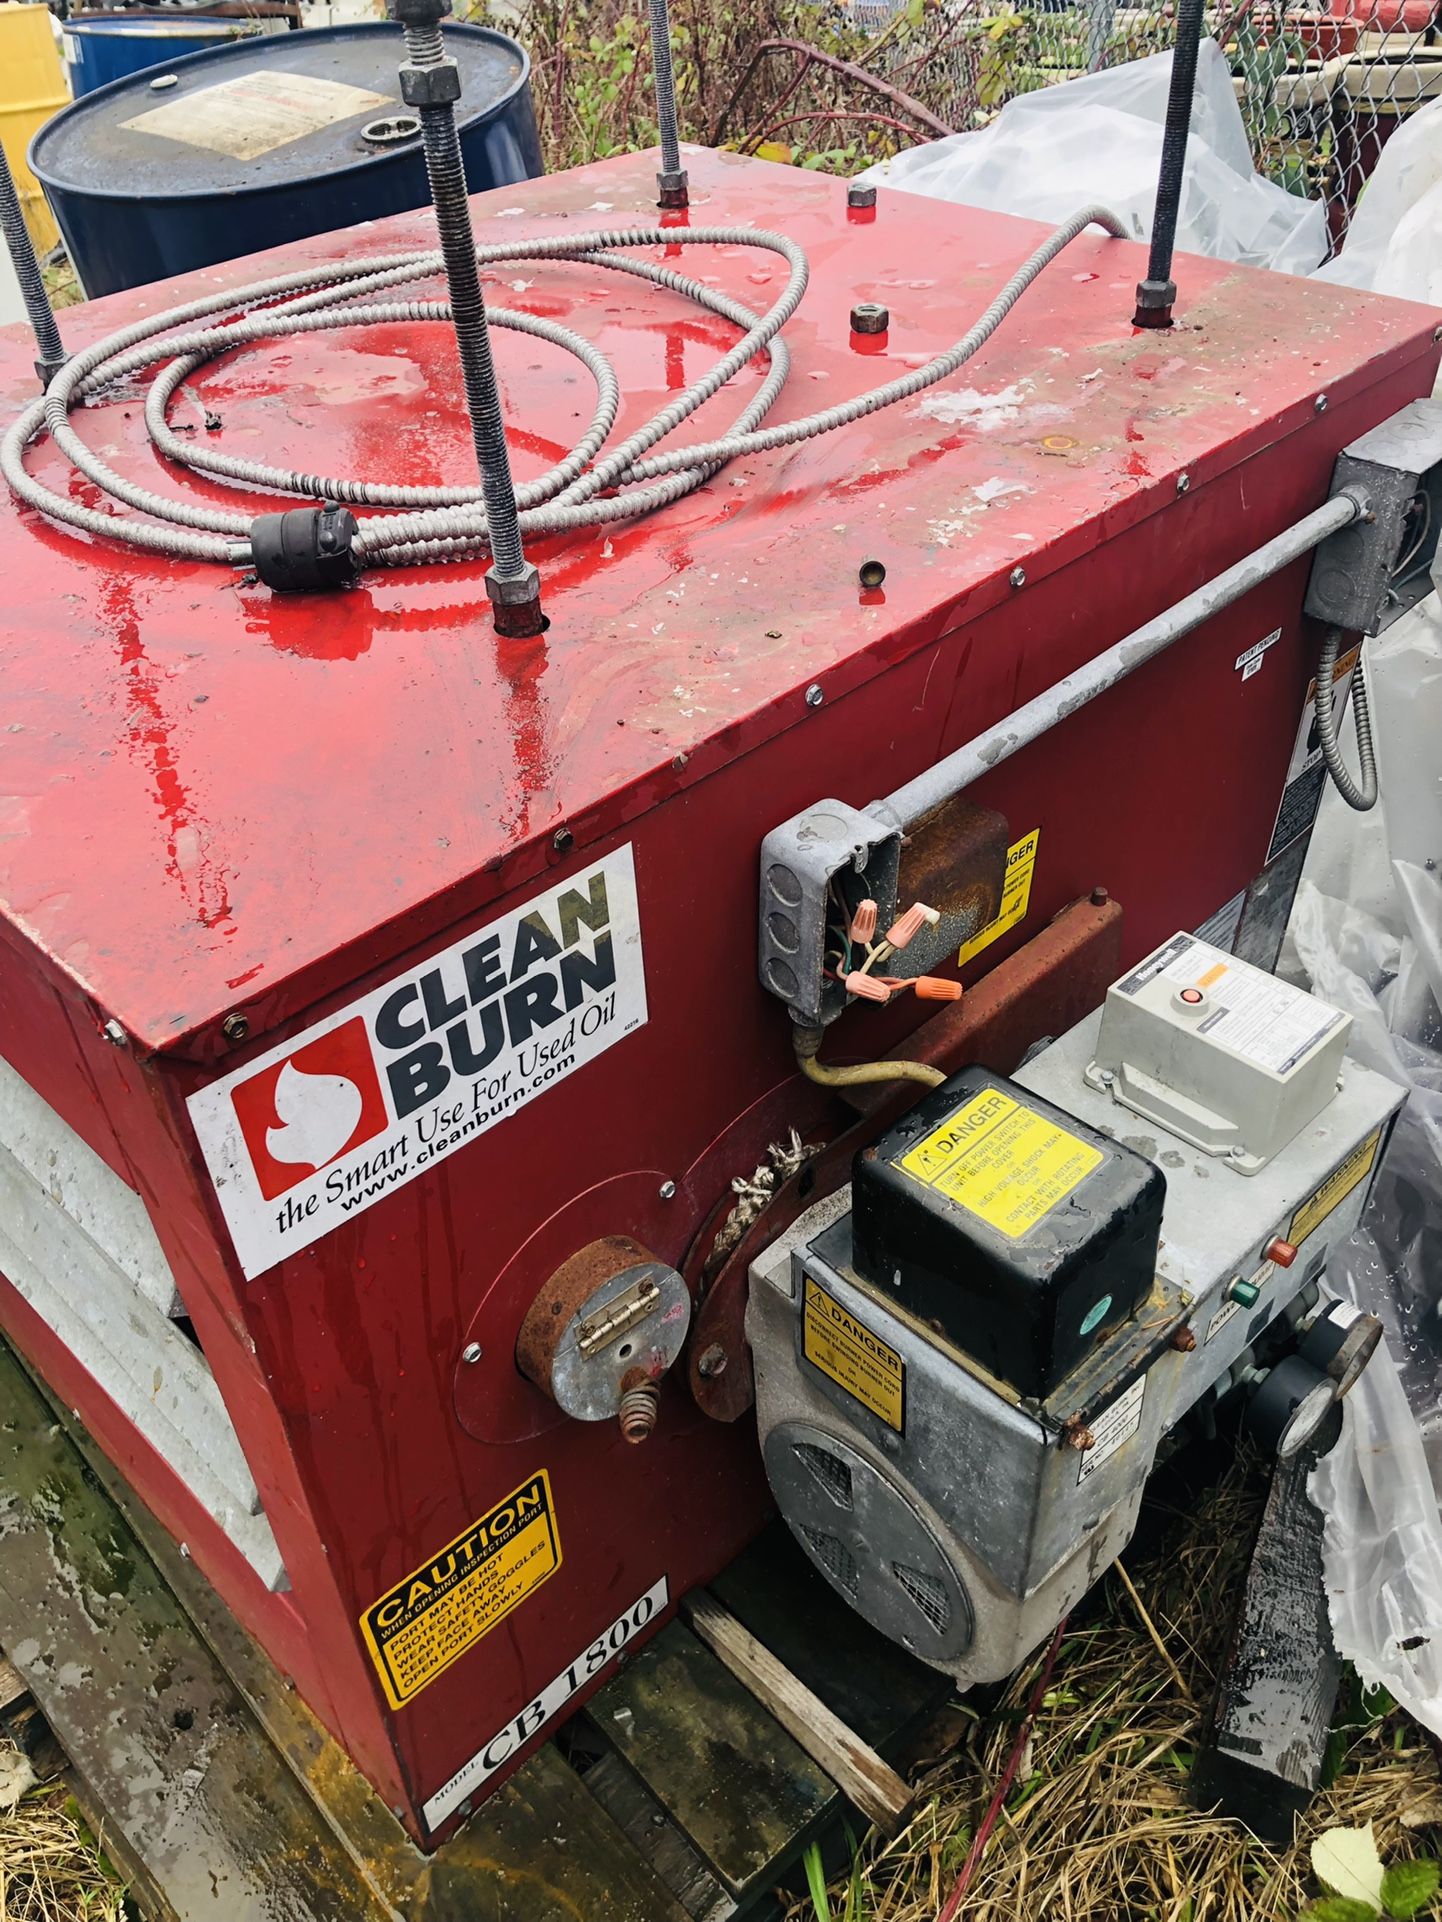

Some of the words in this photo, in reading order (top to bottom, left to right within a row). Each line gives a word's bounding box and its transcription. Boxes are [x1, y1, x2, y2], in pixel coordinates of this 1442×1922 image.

[375, 871, 610, 1049] CLEAN
[386, 929, 616, 1119] BURN
[276, 1194, 319, 1233] the
[325, 1135, 407, 1202] Smart
[415, 1102, 464, 1142] Use
[471, 1070, 511, 1112] For
[518, 1017, 575, 1077] Used
[580, 991, 615, 1035] Oil
[341, 1054, 574, 1209] www.cleanburn.com
[934, 1095, 1007, 1154] DANGER
[940, 1170, 960, 1187] TURN
[957, 1158, 973, 1171] OFF
[971, 1140, 996, 1160] POWER
[993, 1119, 1020, 1140] SWITCH
[1018, 1110, 1030, 1119] TO
[950, 1175, 970, 1191] UNIT
[967, 1153, 995, 1176] BEFORE
[991, 1130, 1021, 1155] OPENING
[1019, 1118, 1036, 1131] THIS
[977, 1190, 997, 1207] HIGH
[995, 1167, 1024, 1191] VOLTAGE
[1021, 1148, 1045, 1168] SHOCK
[1042, 1135, 1060, 1149] MAY
[991, 1149, 1014, 1168] COVER
[1005, 1195, 1037, 1222] CONTACT
[1034, 1178, 1055, 1196] WITH
[1052, 1151, 1085, 1179] ROTATING
[1016, 1165, 1041, 1186] OCCUR
[1024, 1198, 1049, 1219] PARTS
[1045, 1185, 1063, 1200] MAY
[1060, 1165, 1084, 1185] OCCUR
[831, 1308, 899, 1371] DANGER
[1210, 1301, 1236, 1331] POWE
[863, 1356, 883, 1378] POWER
[377, 1485, 539, 1626] CAUTION
[381, 1611, 411, 1638] WHEN
[414, 1574, 457, 1612] OPENING
[460, 1525, 515, 1574] INSPECTION
[518, 1502, 541, 1526] PORT
[390, 1618, 424, 1651] PORT
[428, 1593, 454, 1619] MAY
[458, 1577, 475, 1594] BE
[478, 1552, 502, 1578] HOT
[393, 1607, 451, 1660] PROTECT
[456, 1570, 498, 1608] HANDS
[396, 1635, 435, 1668] WEAR
[438, 1592, 484, 1635] SAFETY
[488, 1540, 545, 1592] GOGGLES
[400, 1647, 433, 1679] KEEP
[437, 1617, 469, 1648] FACE
[473, 1585, 504, 1618] AWAY
[403, 1655, 438, 1687] OPEN
[441, 1624, 473, 1656] PORT
[476, 1581, 522, 1625] SLOWLY
[434, 1758, 478, 1801] MODEL
[482, 1700, 545, 1769] CB
[563, 1596, 652, 1695] 1800
